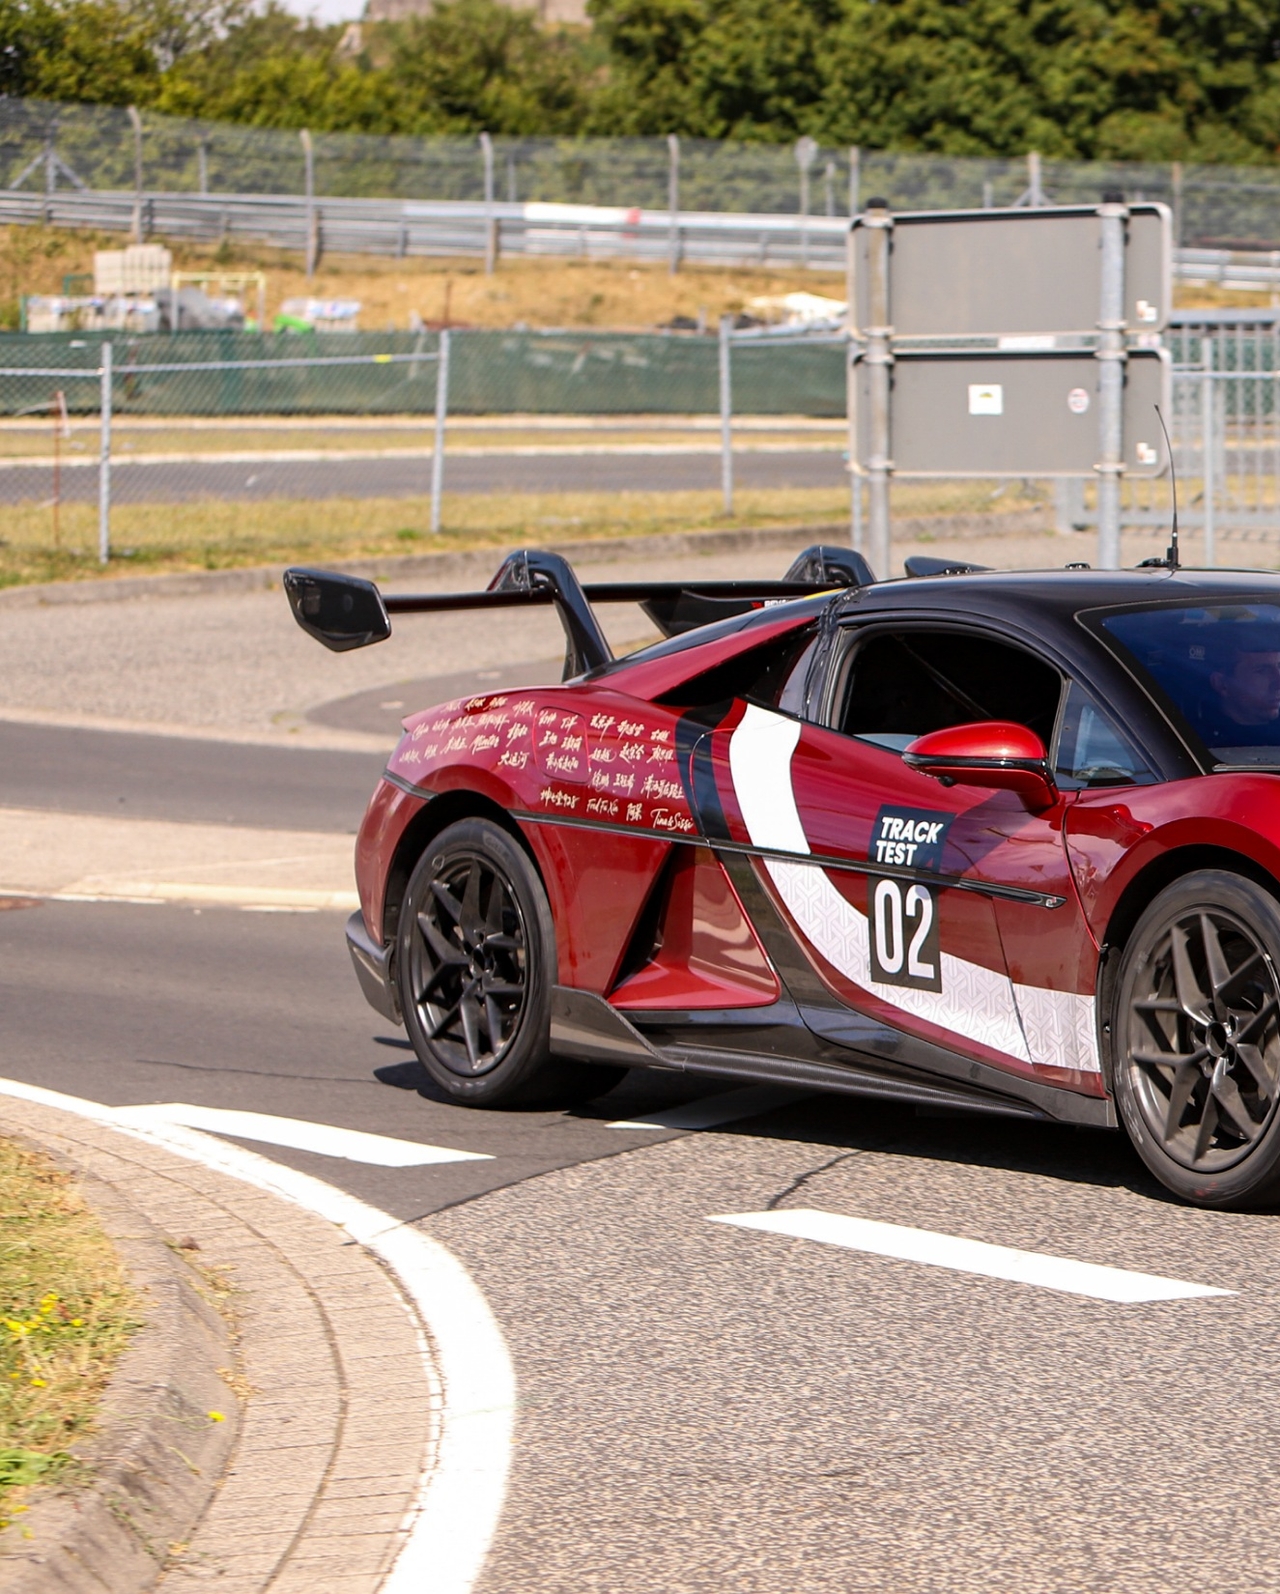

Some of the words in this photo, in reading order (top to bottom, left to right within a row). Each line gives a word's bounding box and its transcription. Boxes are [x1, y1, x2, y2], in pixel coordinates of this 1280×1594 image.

[880, 816, 944, 844] TRACK
[875, 840, 918, 866] TEST
[874, 879, 935, 979] 02
